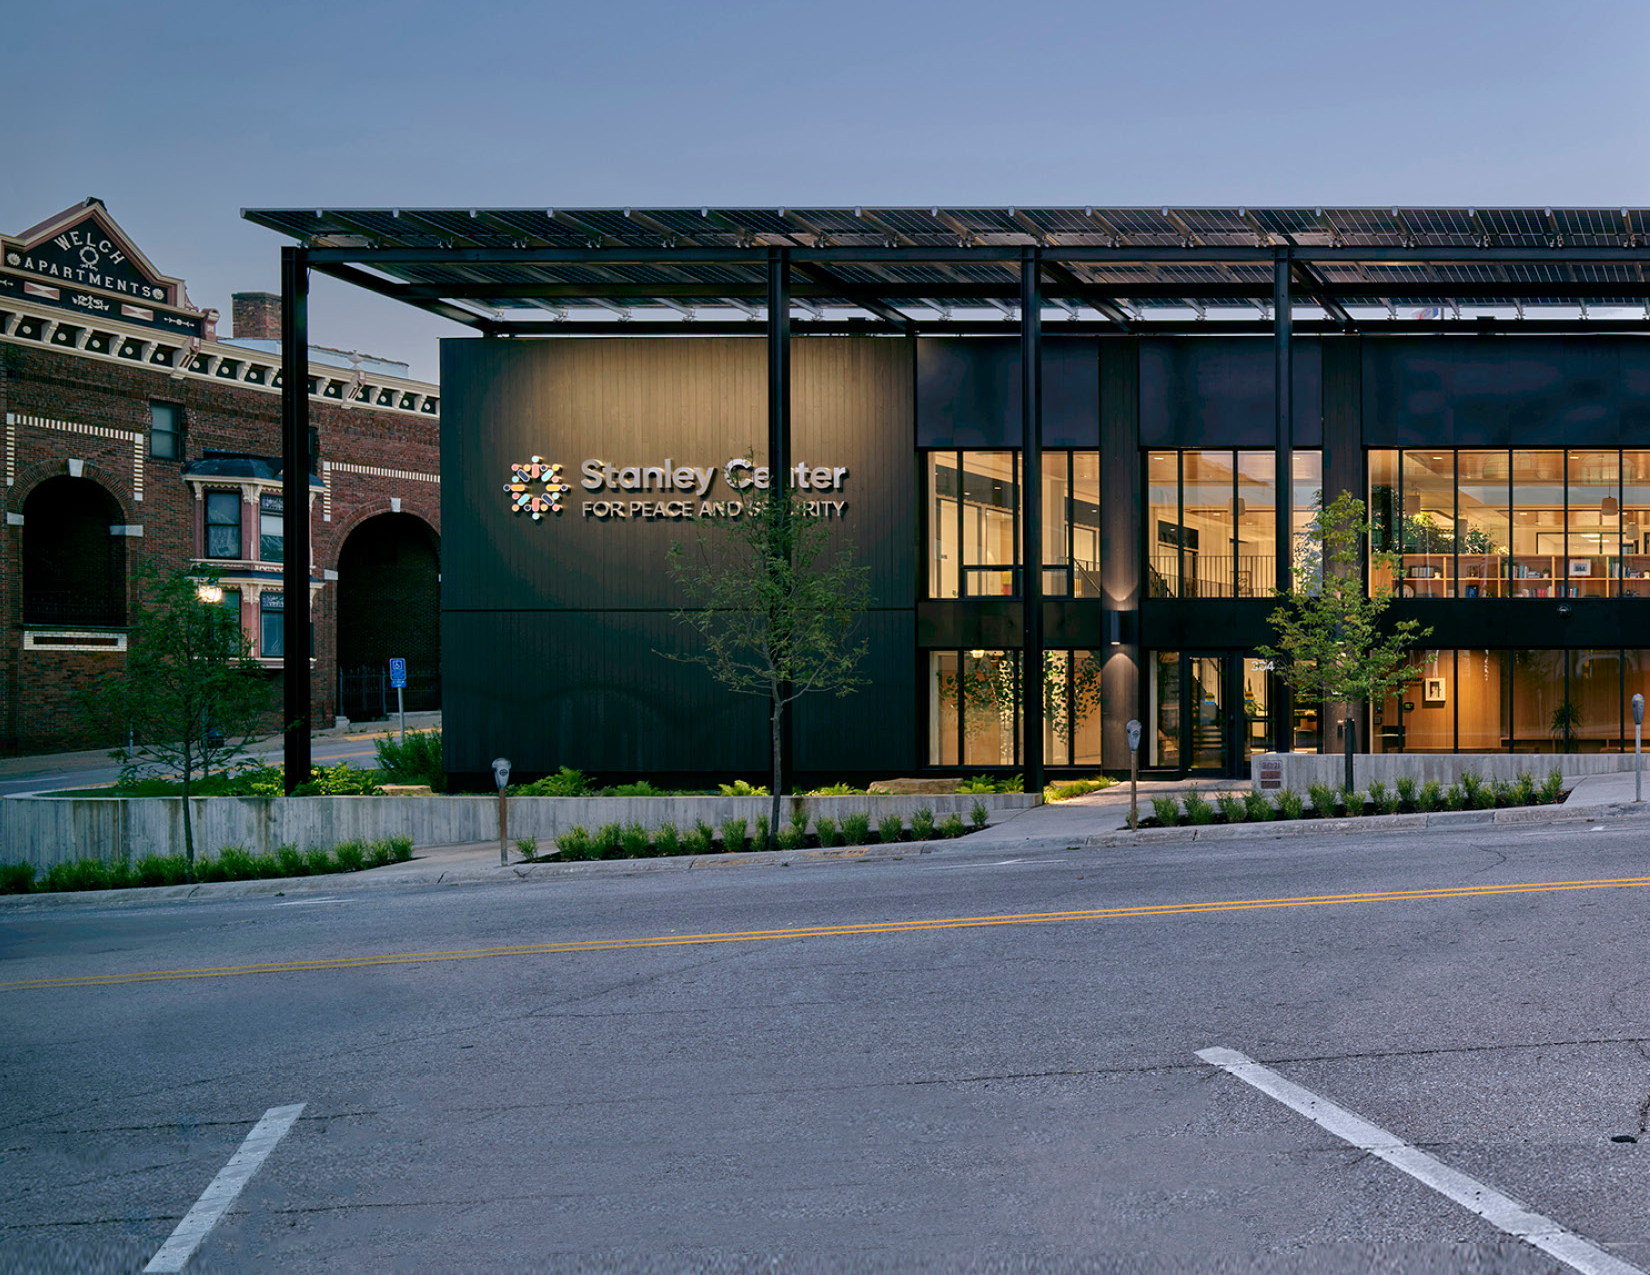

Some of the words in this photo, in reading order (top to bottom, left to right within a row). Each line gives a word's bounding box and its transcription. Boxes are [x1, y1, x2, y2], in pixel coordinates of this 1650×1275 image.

[54, 230, 125, 265] WELCH
[24, 256, 151, 297] APARTMENTS
[580, 458, 715, 496] Stanley
[723, 458, 846, 489] Ceter
[582, 501, 624, 517] FOR
[629, 501, 692, 517] PEACE
[698, 501, 741, 517] AND
[1251, 660, 1275, 672] 304
